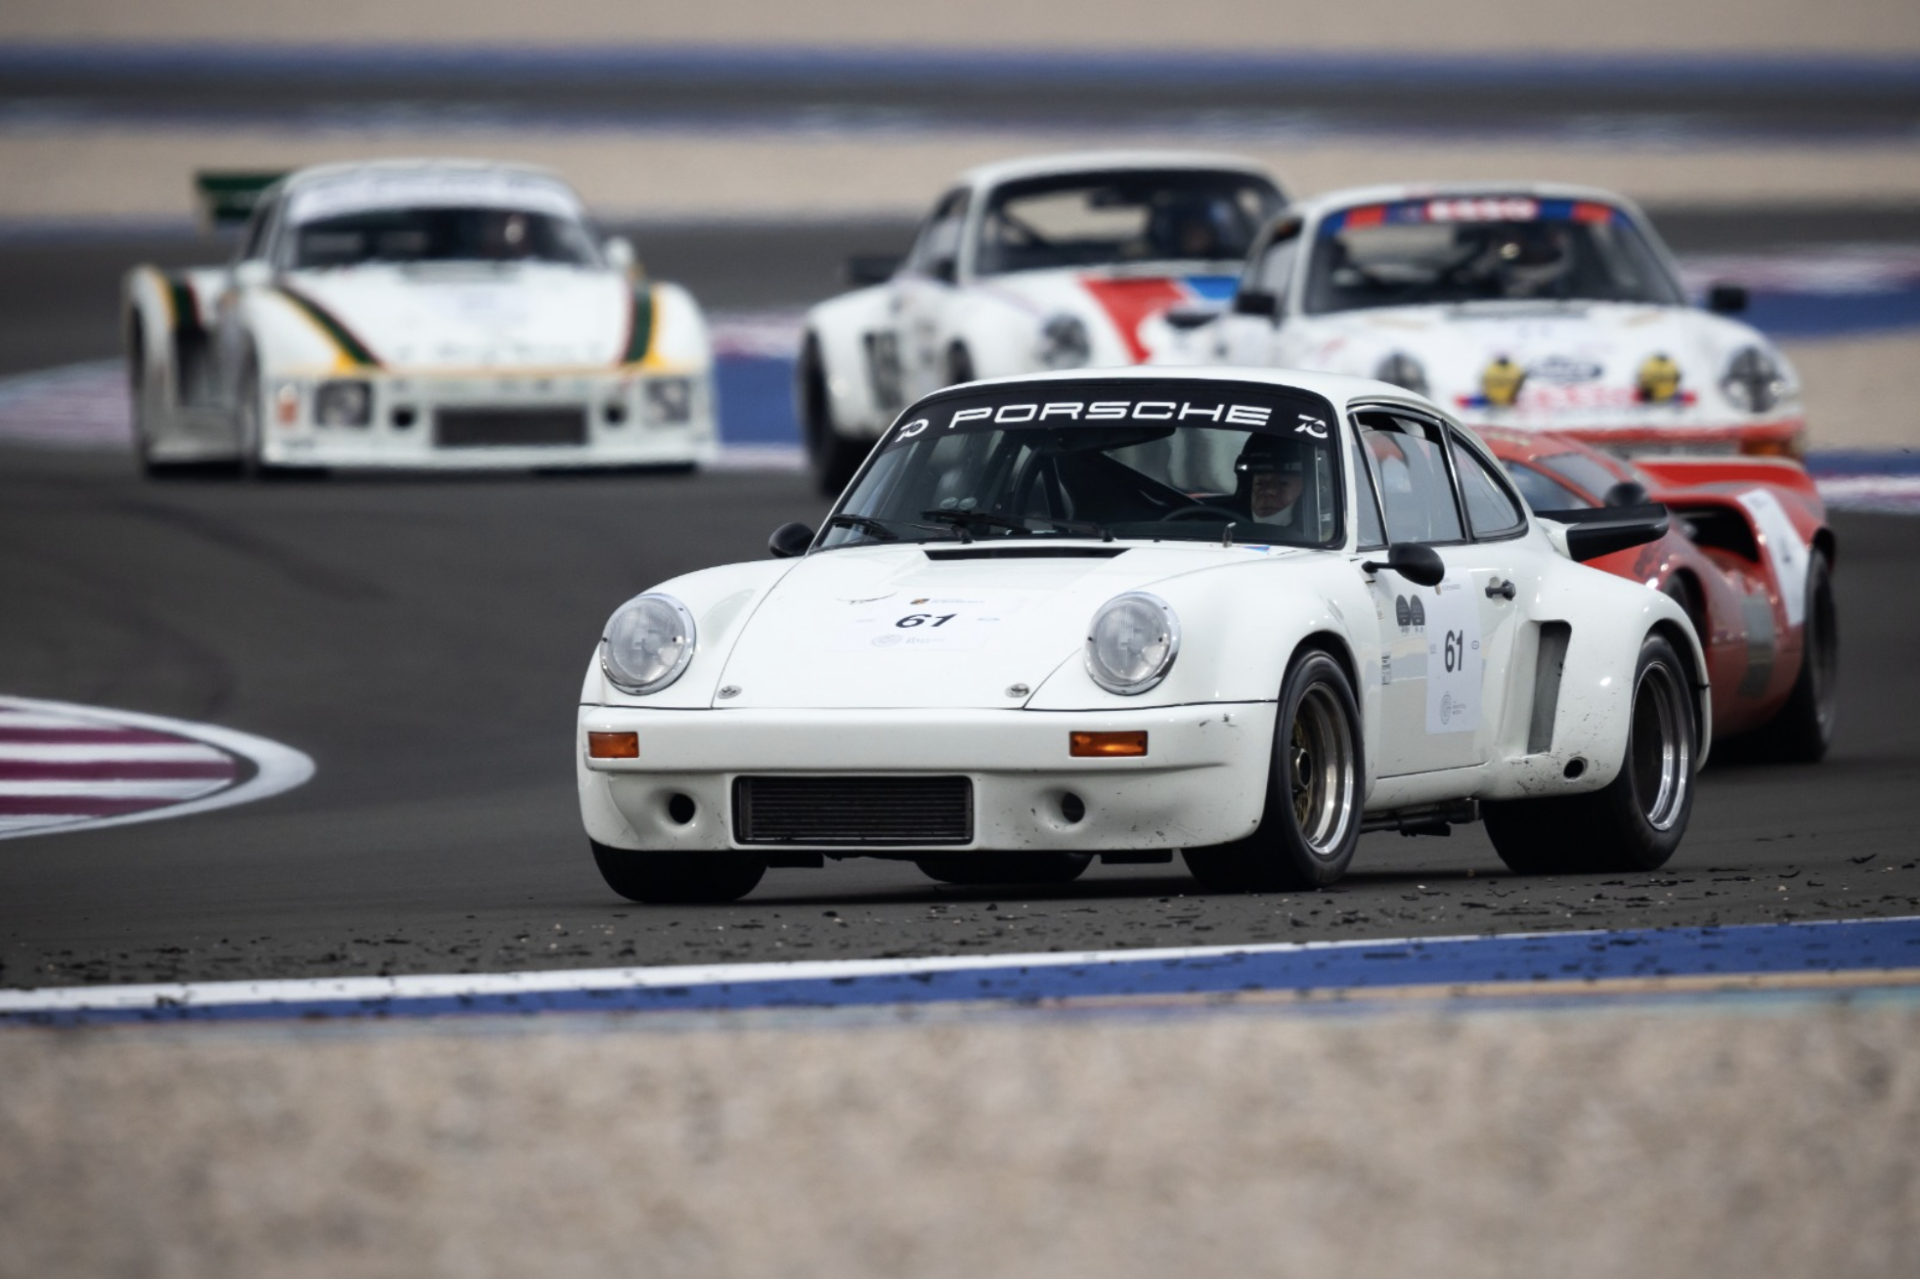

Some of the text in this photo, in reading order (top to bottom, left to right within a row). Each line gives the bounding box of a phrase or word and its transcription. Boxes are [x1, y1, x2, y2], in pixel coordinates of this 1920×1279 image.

[948, 401, 1273, 429] PORSCHE
[895, 613, 958, 628] 61
[1444, 629, 1464, 673] 61
